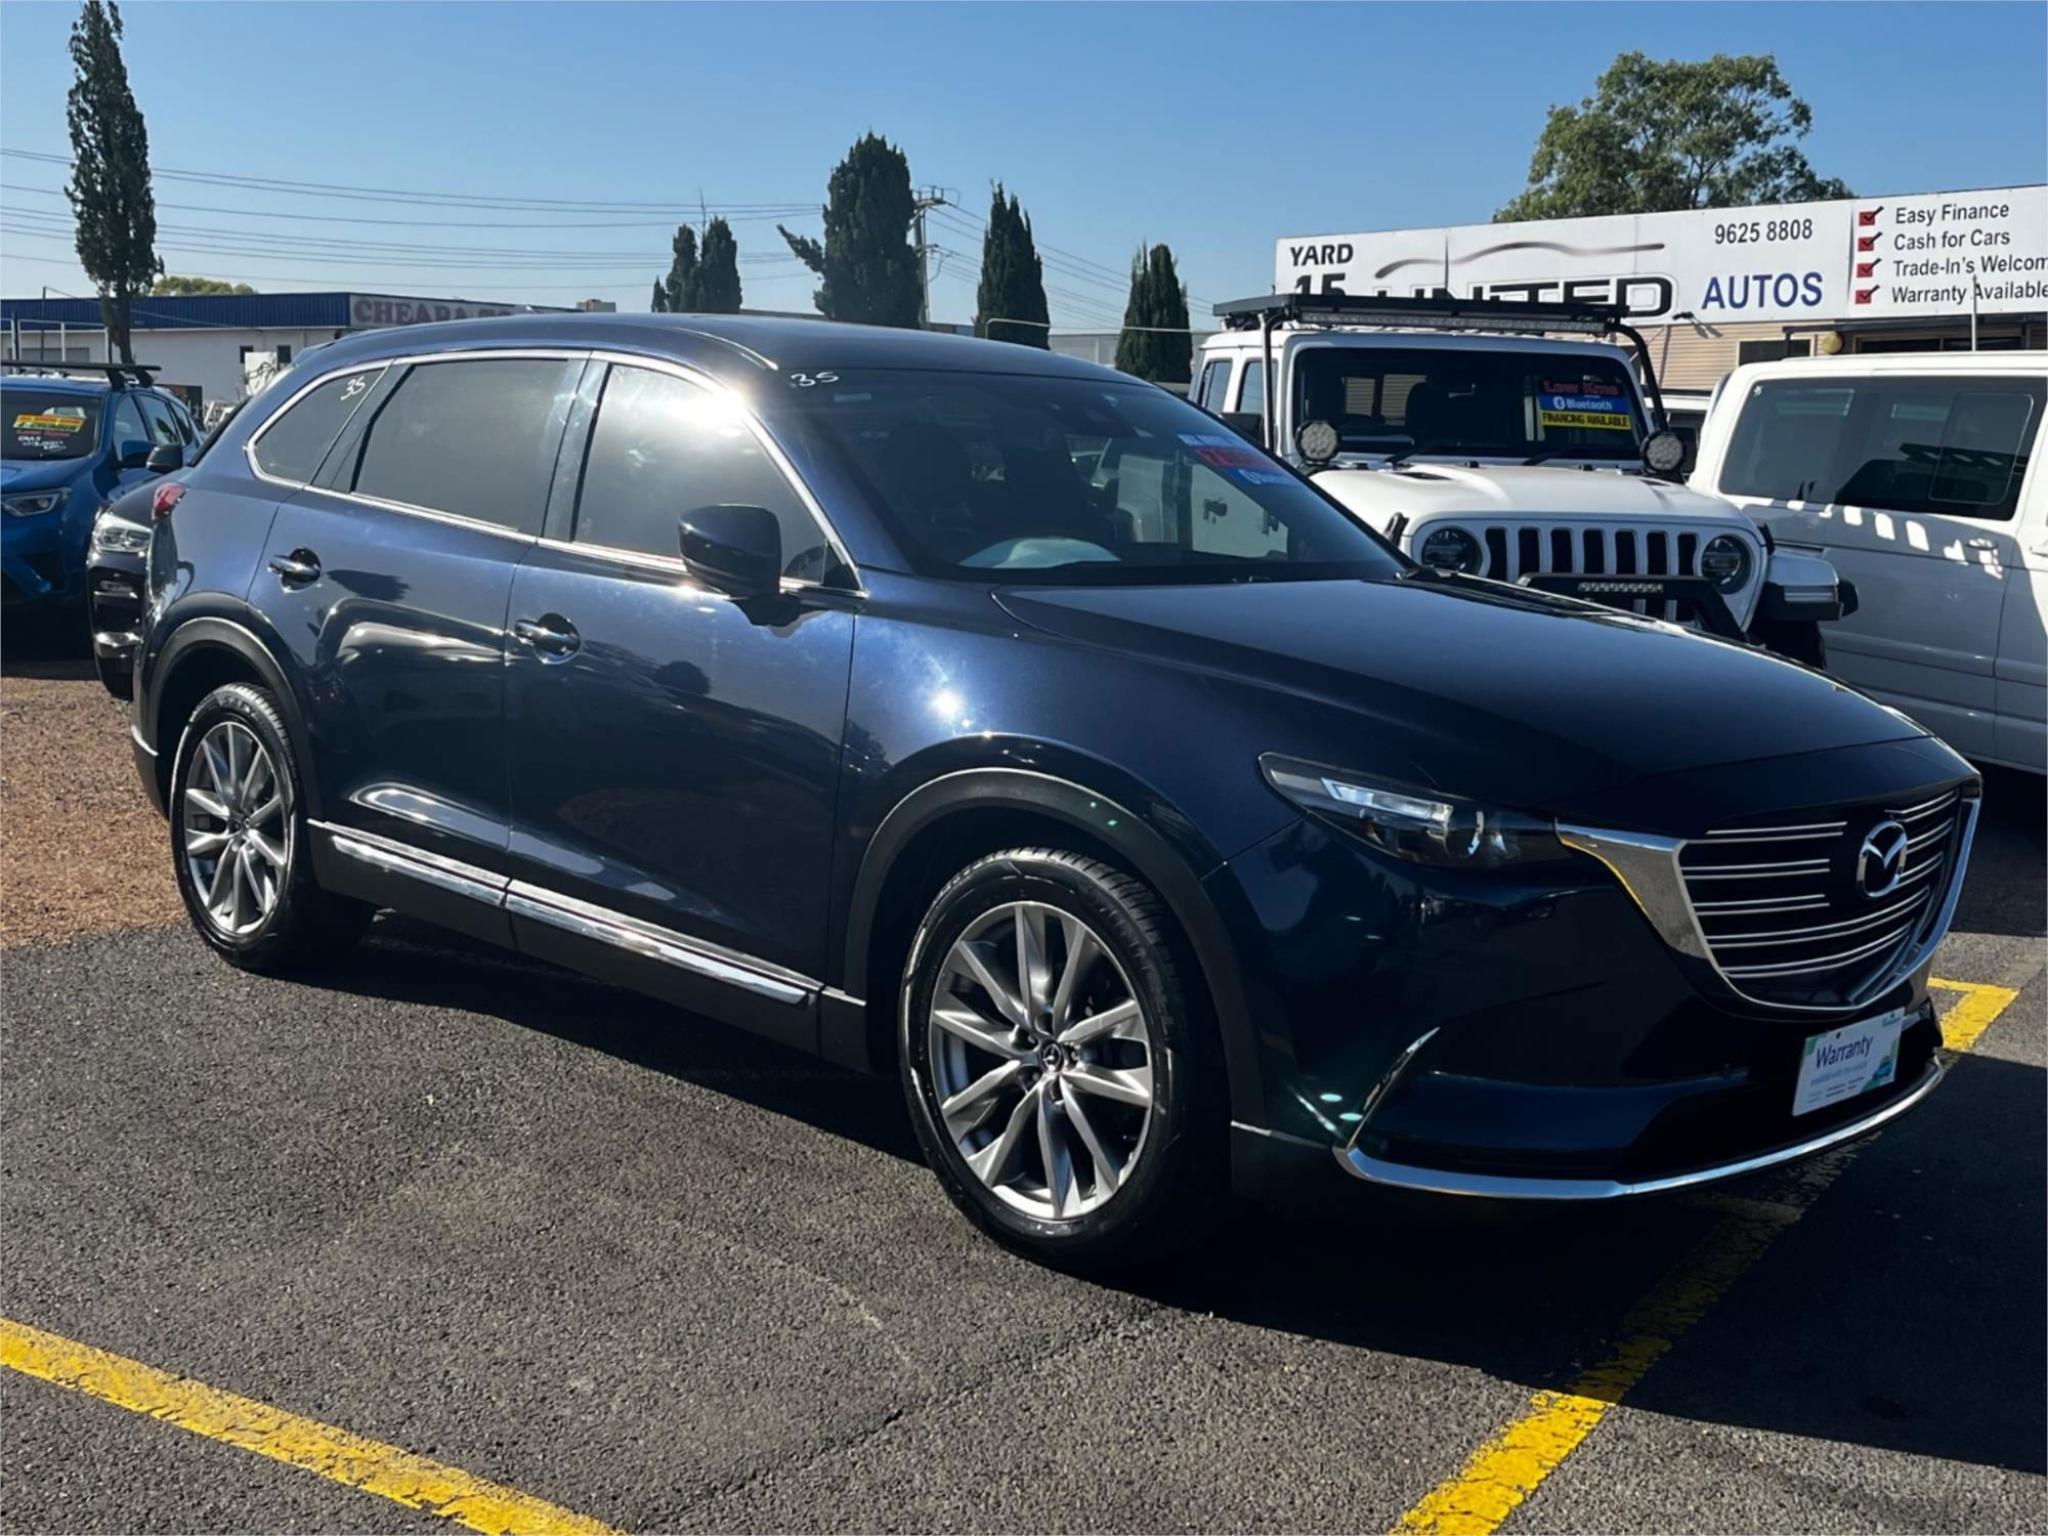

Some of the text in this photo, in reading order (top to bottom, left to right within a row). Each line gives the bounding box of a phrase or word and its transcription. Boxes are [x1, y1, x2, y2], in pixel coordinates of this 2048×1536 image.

[1895, 203, 2010, 227] Easy Finance
[1715, 218, 1813, 244] 9625 8808
[1894, 228, 2011, 251] Cash for Cars
[1290, 243, 1354, 267] YARD
[1893, 256, 1975, 277] Trade-In's
[1296, 273, 1346, 296] 15
[1378, 276, 1673, 317] TED
[1701, 271, 1823, 310] AUTOS
[1892, 281, 2047, 305] Warranty Available
[1566, 398, 1614, 410] Bluetooth
[1815, 1035, 1874, 1069] Warranty
